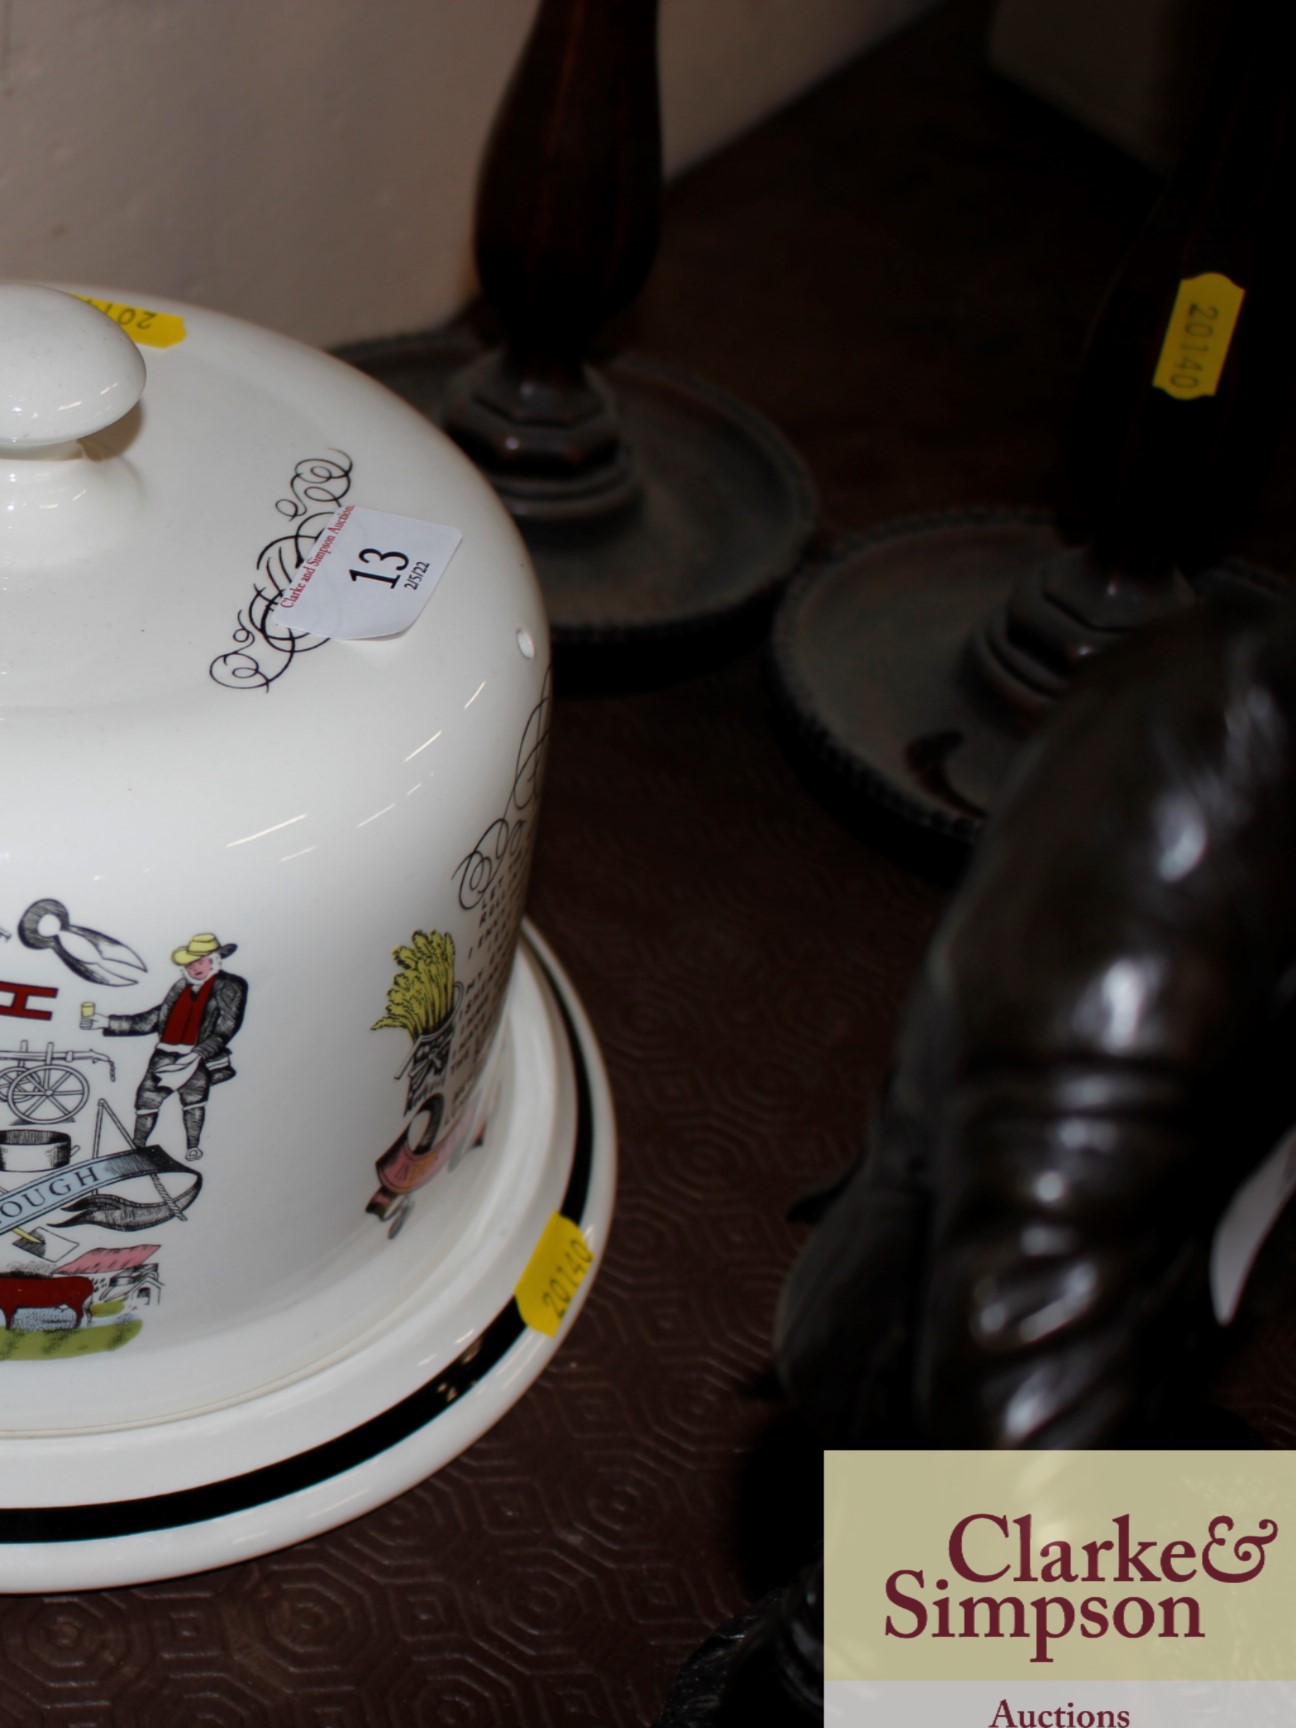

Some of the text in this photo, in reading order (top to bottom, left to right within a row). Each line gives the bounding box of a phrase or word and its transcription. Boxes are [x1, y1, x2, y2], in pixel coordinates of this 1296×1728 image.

[1169, 301, 1219, 389] 20140
[306, 535, 336, 567] Simpson
[301, 566, 316, 583] and
[349, 548, 410, 589] 13
[403, 561, 431, 591] 2/5/22
[280, 581, 306, 609] Clarke
